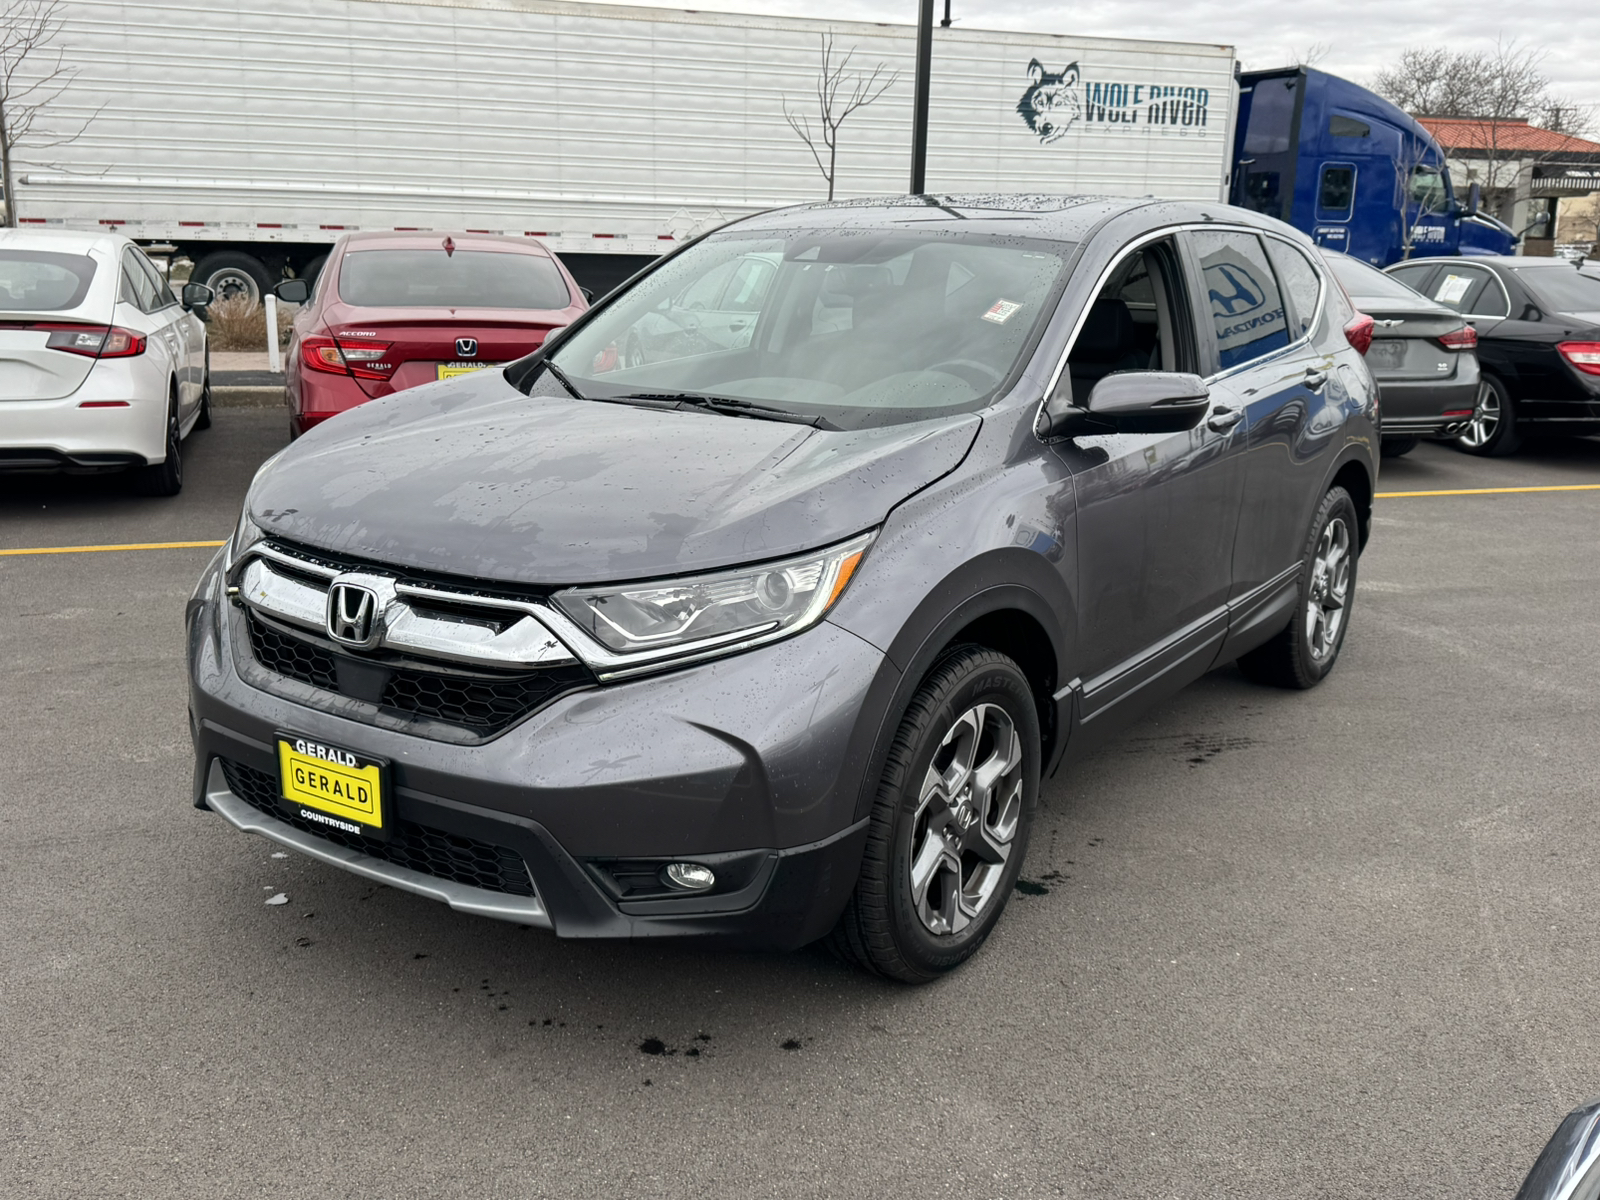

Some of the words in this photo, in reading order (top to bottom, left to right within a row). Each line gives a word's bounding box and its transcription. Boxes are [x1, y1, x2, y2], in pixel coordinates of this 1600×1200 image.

[1085, 82, 1145, 123] WOLF
[1147, 85, 1209, 126] RIVER
[296, 740, 356, 767] GERALD
[295, 767, 368, 804] GERALD
[300, 809, 361, 835] COUNTRYSIDE
